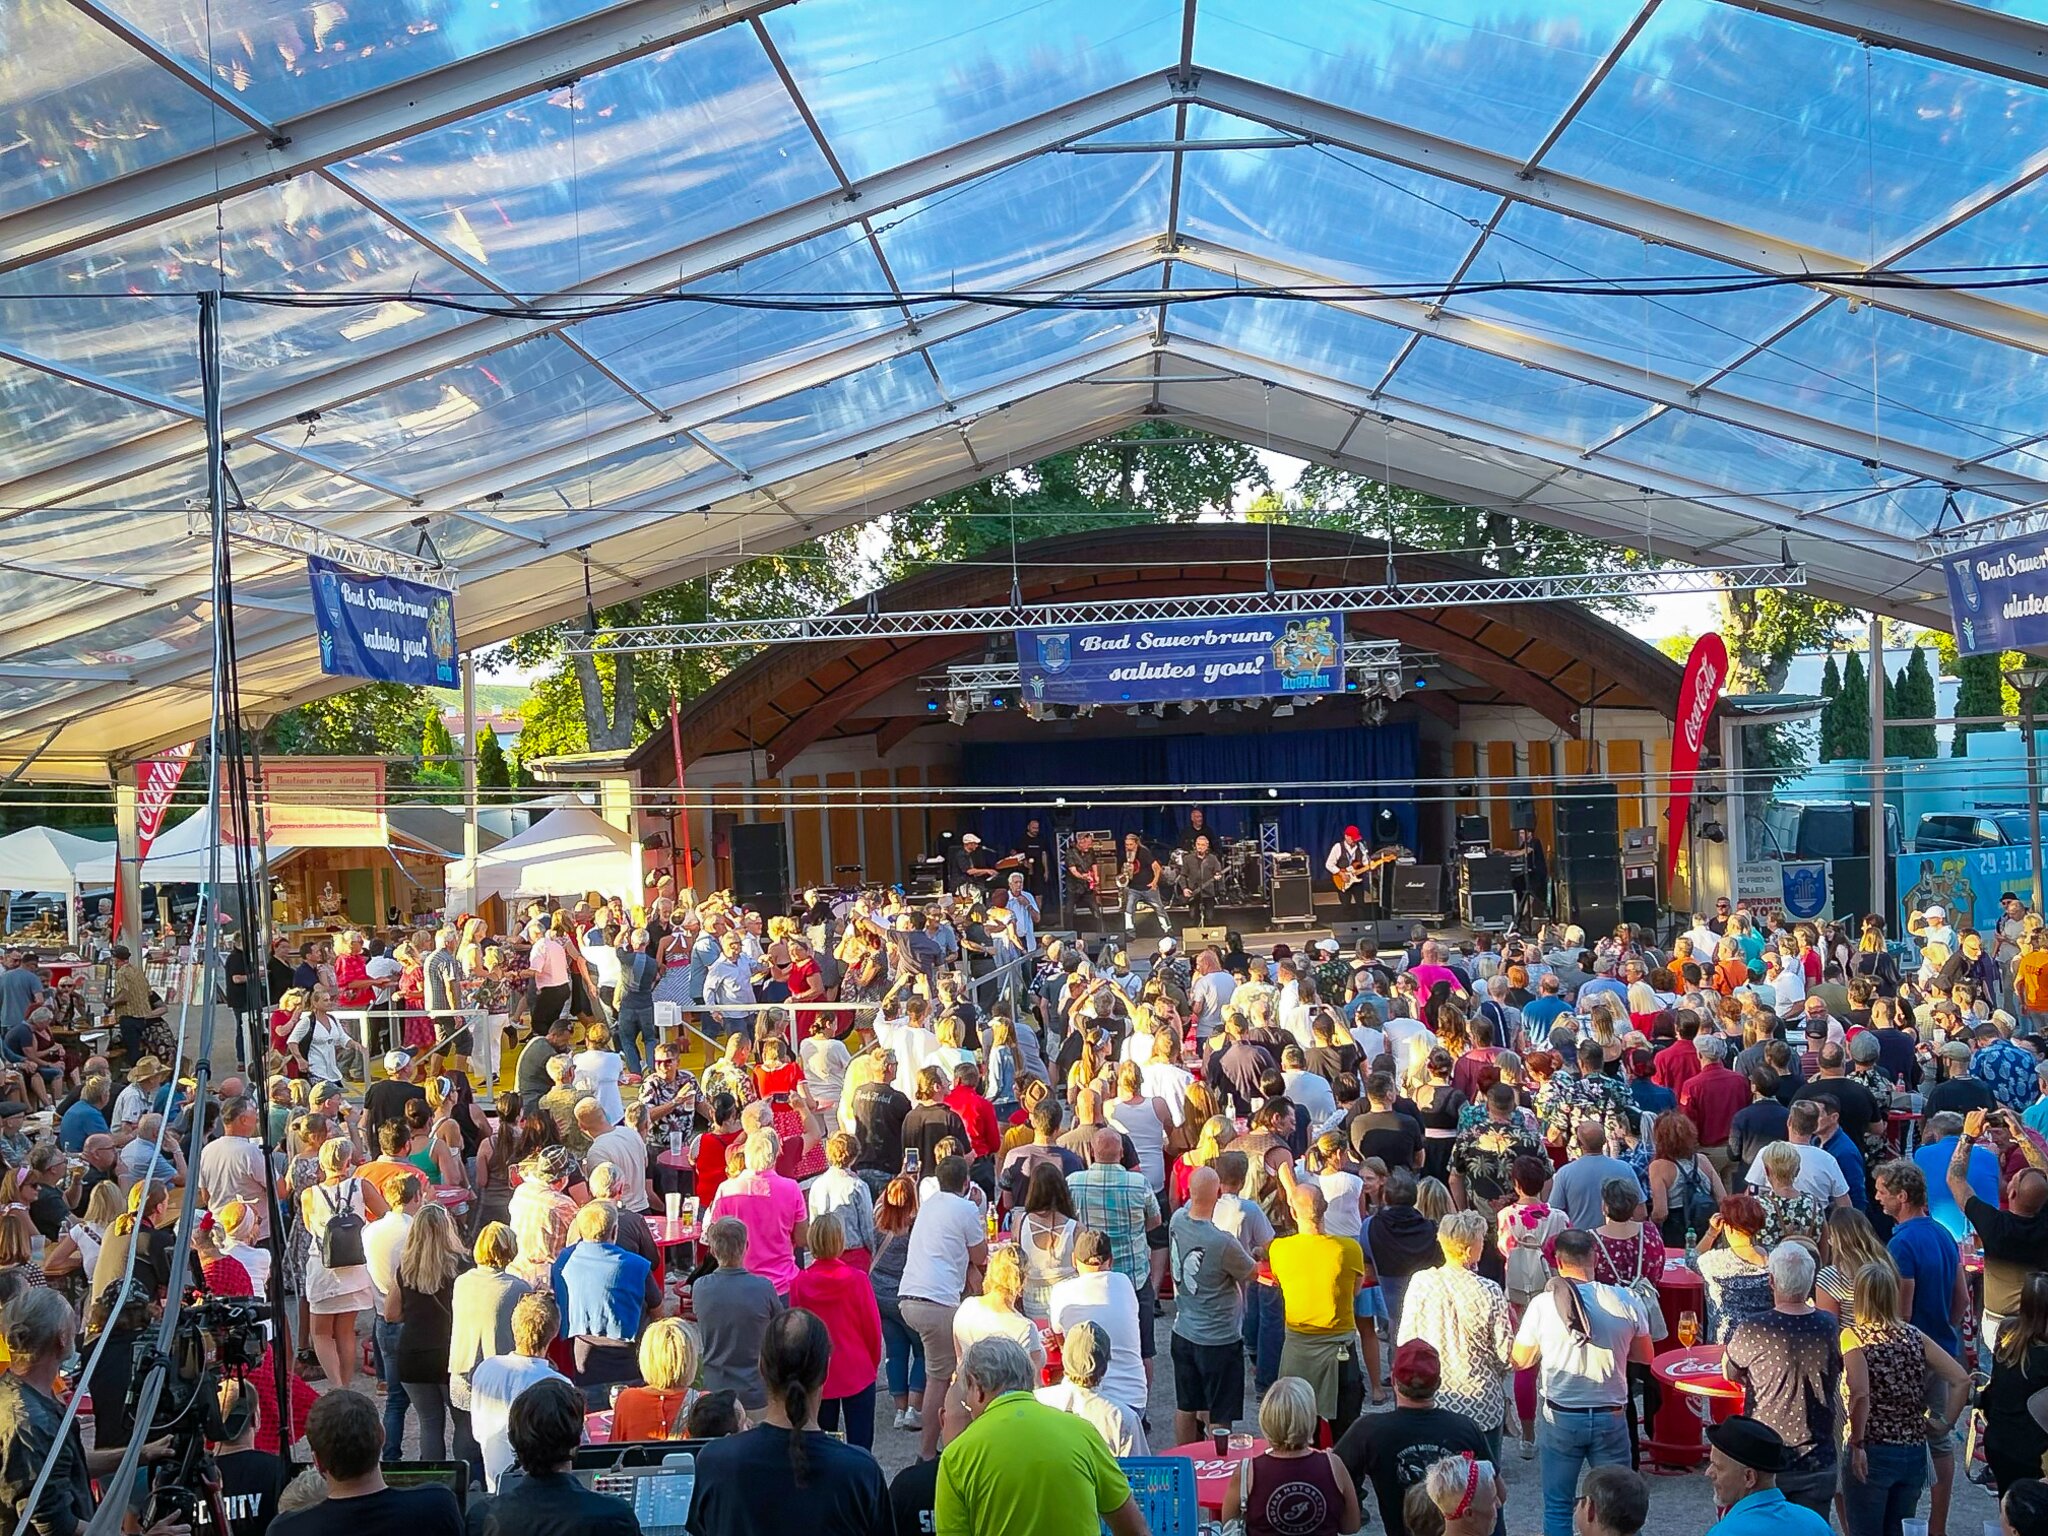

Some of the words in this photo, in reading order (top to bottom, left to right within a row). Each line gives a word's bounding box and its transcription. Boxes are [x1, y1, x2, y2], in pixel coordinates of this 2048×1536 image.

[1977, 557, 2006, 581] Bad
[341, 582, 366, 607] Bad
[367, 589, 428, 619] Sauerbrunn
[363, 628, 400, 653] salutes
[403, 636, 428, 663] you!
[1079, 635, 1131, 652] Bad
[1136, 630, 1274, 650] Sauerbrunn
[1109, 661, 1195, 682] salutes
[1202, 656, 1265, 683] you!
[339, 776, 370, 787] vintage
